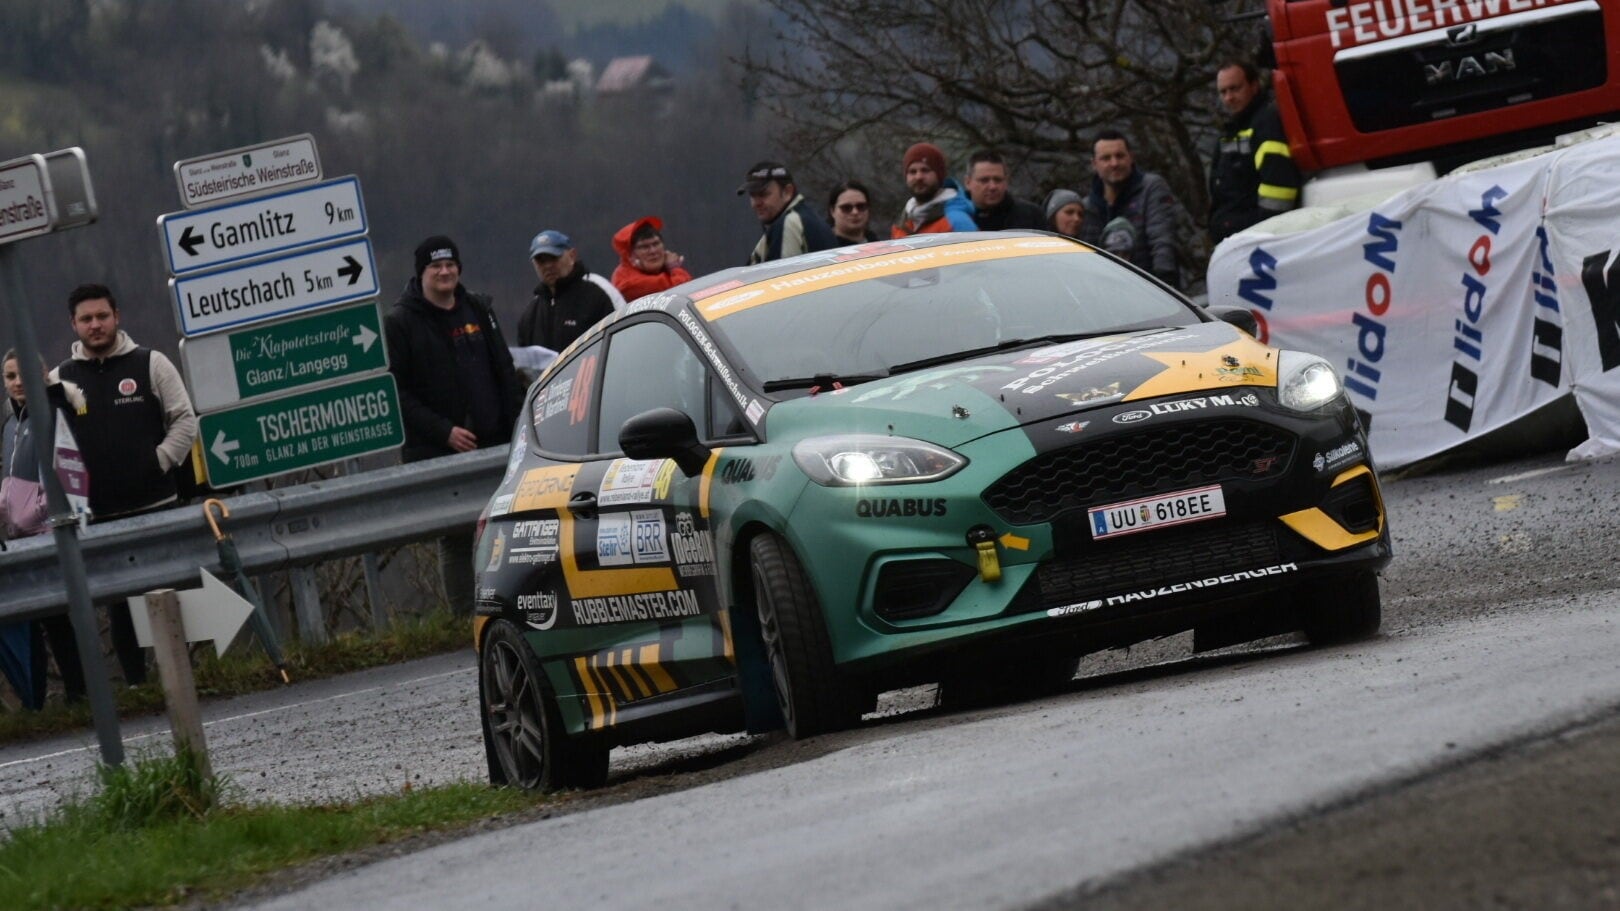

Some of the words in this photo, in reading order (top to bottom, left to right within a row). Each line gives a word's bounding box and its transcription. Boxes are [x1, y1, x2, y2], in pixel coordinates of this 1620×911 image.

[1326, 0, 1563, 47] FEUERW
[187, 171, 256, 199] Südsteirische
[256, 158, 315, 184] Weinstraße
[210, 210, 296, 249] Gamlitz
[325, 201, 335, 225] 9
[337, 206, 354, 223] km
[770, 251, 936, 291] Hauzenberger
[187, 272, 295, 319] Leutschach
[304, 269, 314, 293] 5
[315, 274, 333, 291] km
[236, 348, 251, 362] Die
[246, 352, 348, 387] Glanz/Langegg
[257, 389, 390, 444] TSCHERMONEGG
[1150, 397, 1208, 415] LUKY
[234, 453, 259, 469] 700m
[265, 443, 294, 463] GLANZ
[297, 440, 309, 455] AN
[311, 436, 329, 451] DER
[332, 420, 394, 448] WEINSTRASSE
[856, 498, 947, 519] QUABUS
[1111, 508, 1136, 529] UU
[1156, 494, 1212, 521] 618EE
[637, 523, 662, 552] BRR
[517, 590, 556, 610] eventtaxi
[571, 589, 700, 625] RUBBLEMASTER.COM
